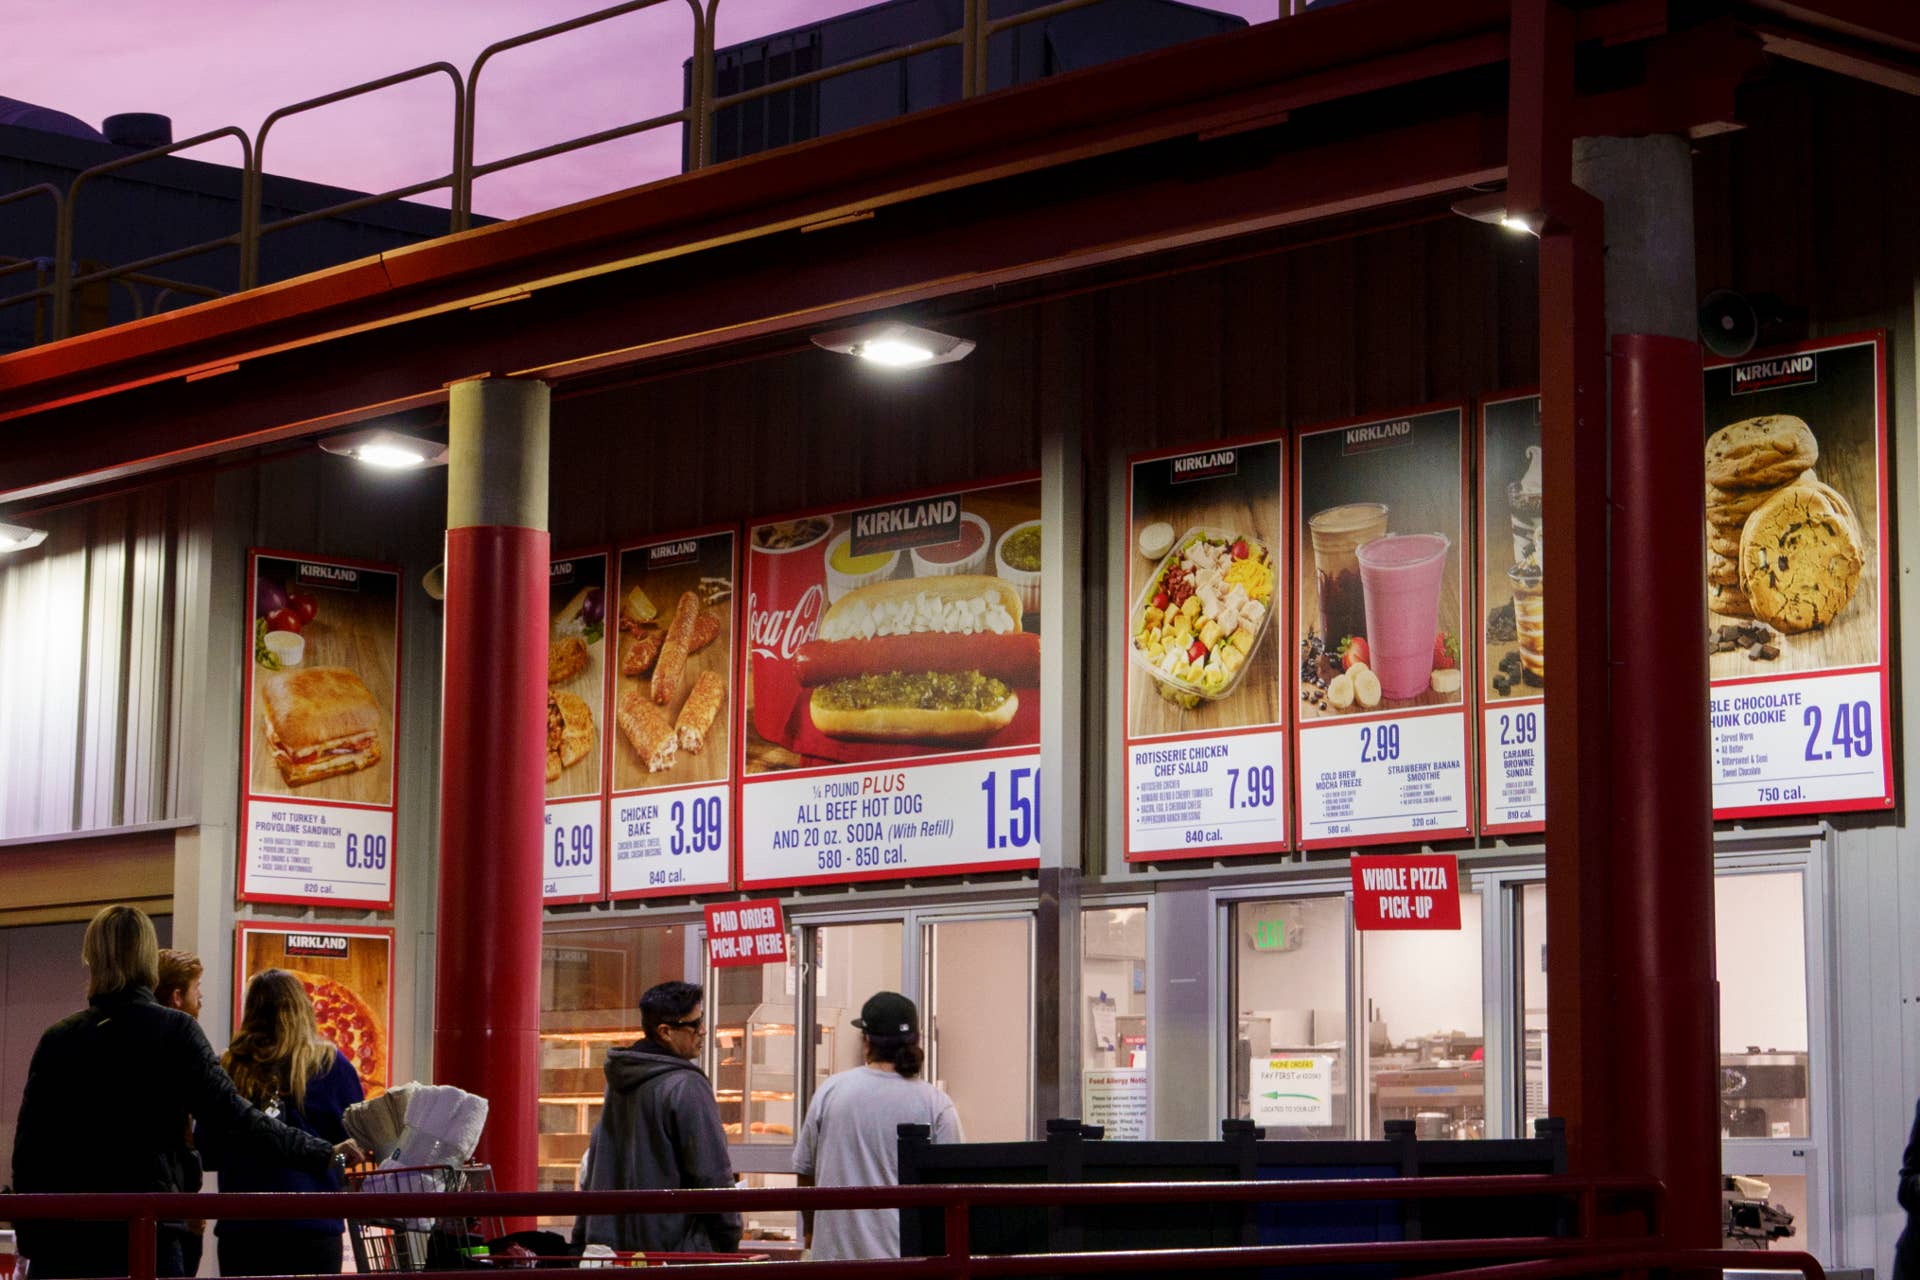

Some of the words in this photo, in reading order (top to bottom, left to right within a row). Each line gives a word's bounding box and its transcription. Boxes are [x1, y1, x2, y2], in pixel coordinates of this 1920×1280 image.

[1736, 357, 1813, 382] KIRKLAND
[1346, 421, 1411, 444] KIRKLAND
[1174, 451, 1235, 473] KIRKLAND
[857, 500, 957, 538] KIRKLAND
[650, 541, 697, 560] KIRKLAND
[300, 564, 357, 582] KIRKLAND
[550, 562, 573, 576] LAND
[1734, 692, 1802, 711] CHOCOLATE
[1500, 712, 1537, 745] 2.99
[1710, 712, 1741, 729] HUNK
[1744, 709, 1787, 725] COOKIE
[1803, 700, 1873, 762] 2.49
[1360, 723, 1400, 763] 2.99
[1135, 749, 1187, 766] ROTISSERIE
[1189, 744, 1229, 760] CHICKEN
[1503, 748, 1535, 760] CARAMEL
[1503, 758, 1535, 769] BROWNIE
[1154, 763, 1176, 777] CHEF
[1178, 760, 1208, 775] SALAD
[1320, 772, 1337, 781] COLD
[1338, 770, 1356, 780] BREW
[1387, 763, 1431, 775] STRAWBERRY
[1433, 760, 1460, 771] BANANA
[1407, 771, 1440, 782] SMOOTHIE
[1505, 768, 1533, 778] SUNDAE
[824, 781, 859, 799] POUND
[862, 773, 906, 795] PLUS
[1227, 765, 1275, 809] 7.99
[1316, 781, 1338, 791] MOCHA
[1339, 778, 1362, 788] FREEZE
[1758, 787, 1780, 802] 750
[1783, 786, 1807, 800] cal.
[620, 805, 659, 823] CHICKEN
[797, 804, 821, 825] ALL
[826, 799, 857, 821] BEEF
[862, 796, 890, 818] HOT
[894, 794, 923, 816] DOG
[981, 767, 1041, 849] 1.5
[271, 812, 289, 822] HOT
[290, 812, 318, 823] TURKEY
[320, 815, 326, 824] &
[670, 796, 722, 856] 3.99
[1425, 816, 1439, 826] cal.
[255, 821, 300, 833] PROVOLONE
[302, 824, 342, 836] SANDWICH
[628, 822, 651, 837] BAKE
[773, 829, 799, 850] AND
[804, 827, 819, 847] 20
[823, 829, 842, 846] oz.
[846, 822, 883, 844] SODA
[887, 822, 917, 844] (With
[920, 818, 955, 839] Refill)
[1185, 831, 1204, 844] 840
[1205, 829, 1223, 842] cal.
[1340, 824, 1353, 834] cal.
[346, 833, 387, 870] 6.99
[554, 824, 593, 868] 6.99
[818, 848, 842, 870] 580
[855, 846, 880, 866] 850
[883, 844, 908, 865] cal.
[649, 870, 666, 885] 840
[668, 868, 686, 883] cal.
[1362, 868, 1408, 891] WHOLE
[1410, 867, 1448, 890] PIZZA
[319, 884, 335, 894] cal.
[1379, 896, 1433, 919] PICK-UP
[711, 910, 738, 933] PAID
[740, 907, 776, 930] ORDER
[288, 935, 347, 950] KIRKLAND
[1258, 920, 1284, 948] EXIT
[711, 935, 754, 960] PICK-UP
[755, 933, 784, 956] HERE
[1106, 1078, 1128, 1086] Allergy
[1130, 1077, 1148, 1085] Notic
[1274, 1072, 1295, 1080] FIRST
